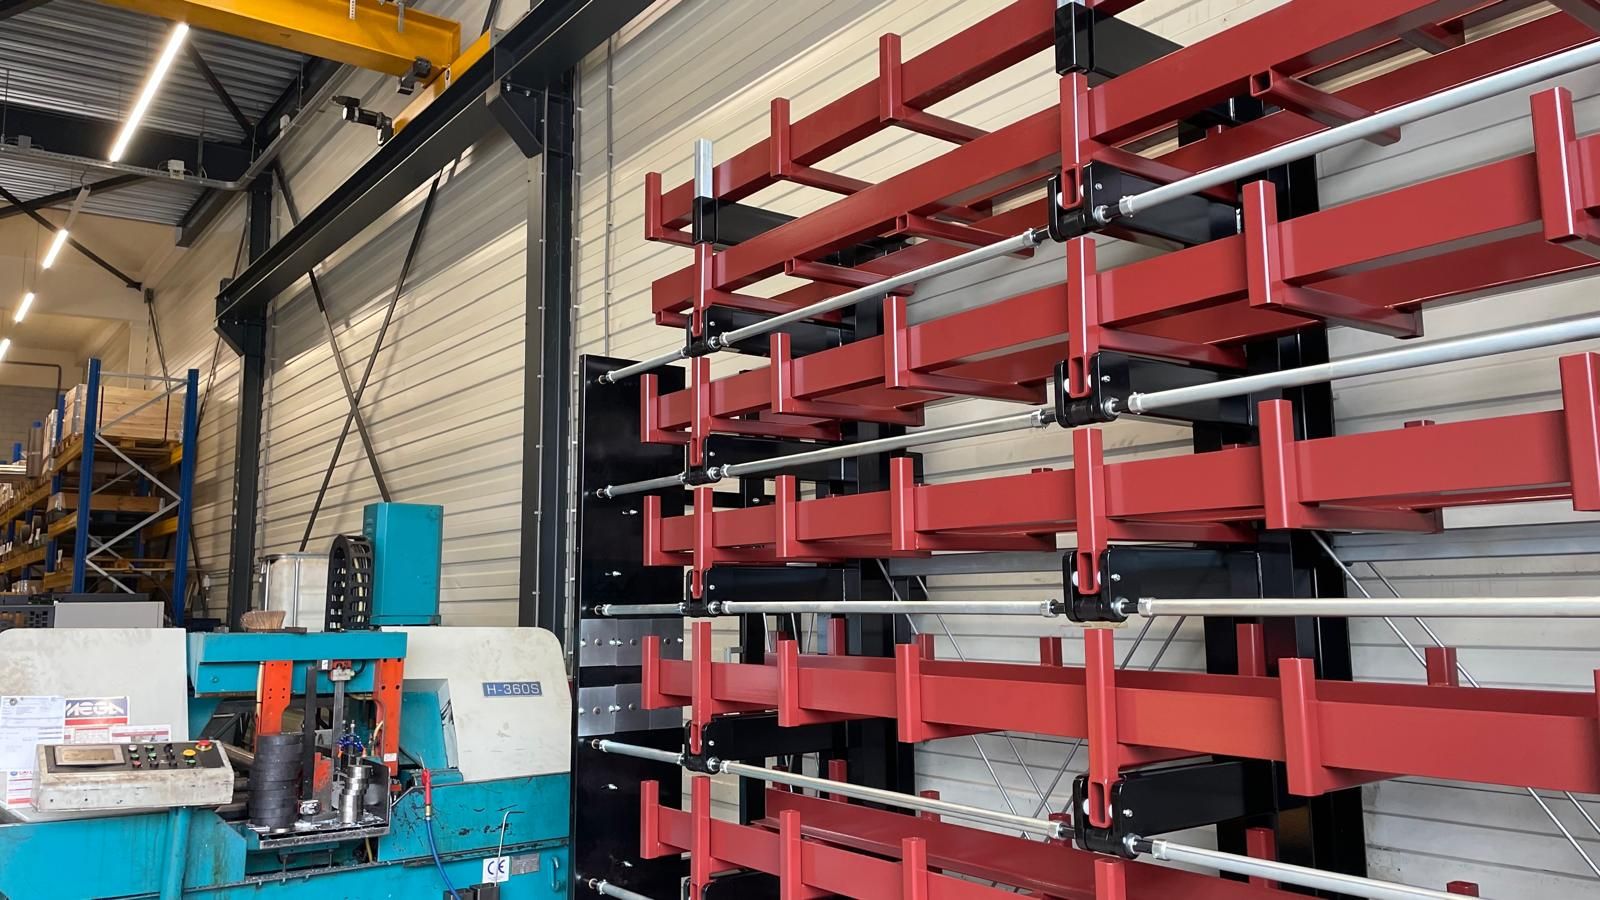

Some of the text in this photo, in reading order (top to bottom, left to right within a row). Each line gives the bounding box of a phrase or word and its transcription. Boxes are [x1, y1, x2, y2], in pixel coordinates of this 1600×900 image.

[486, 683, 540, 695] H-360S
[65, 701, 124, 717] MEGA
[487, 859, 506, 875] CE
